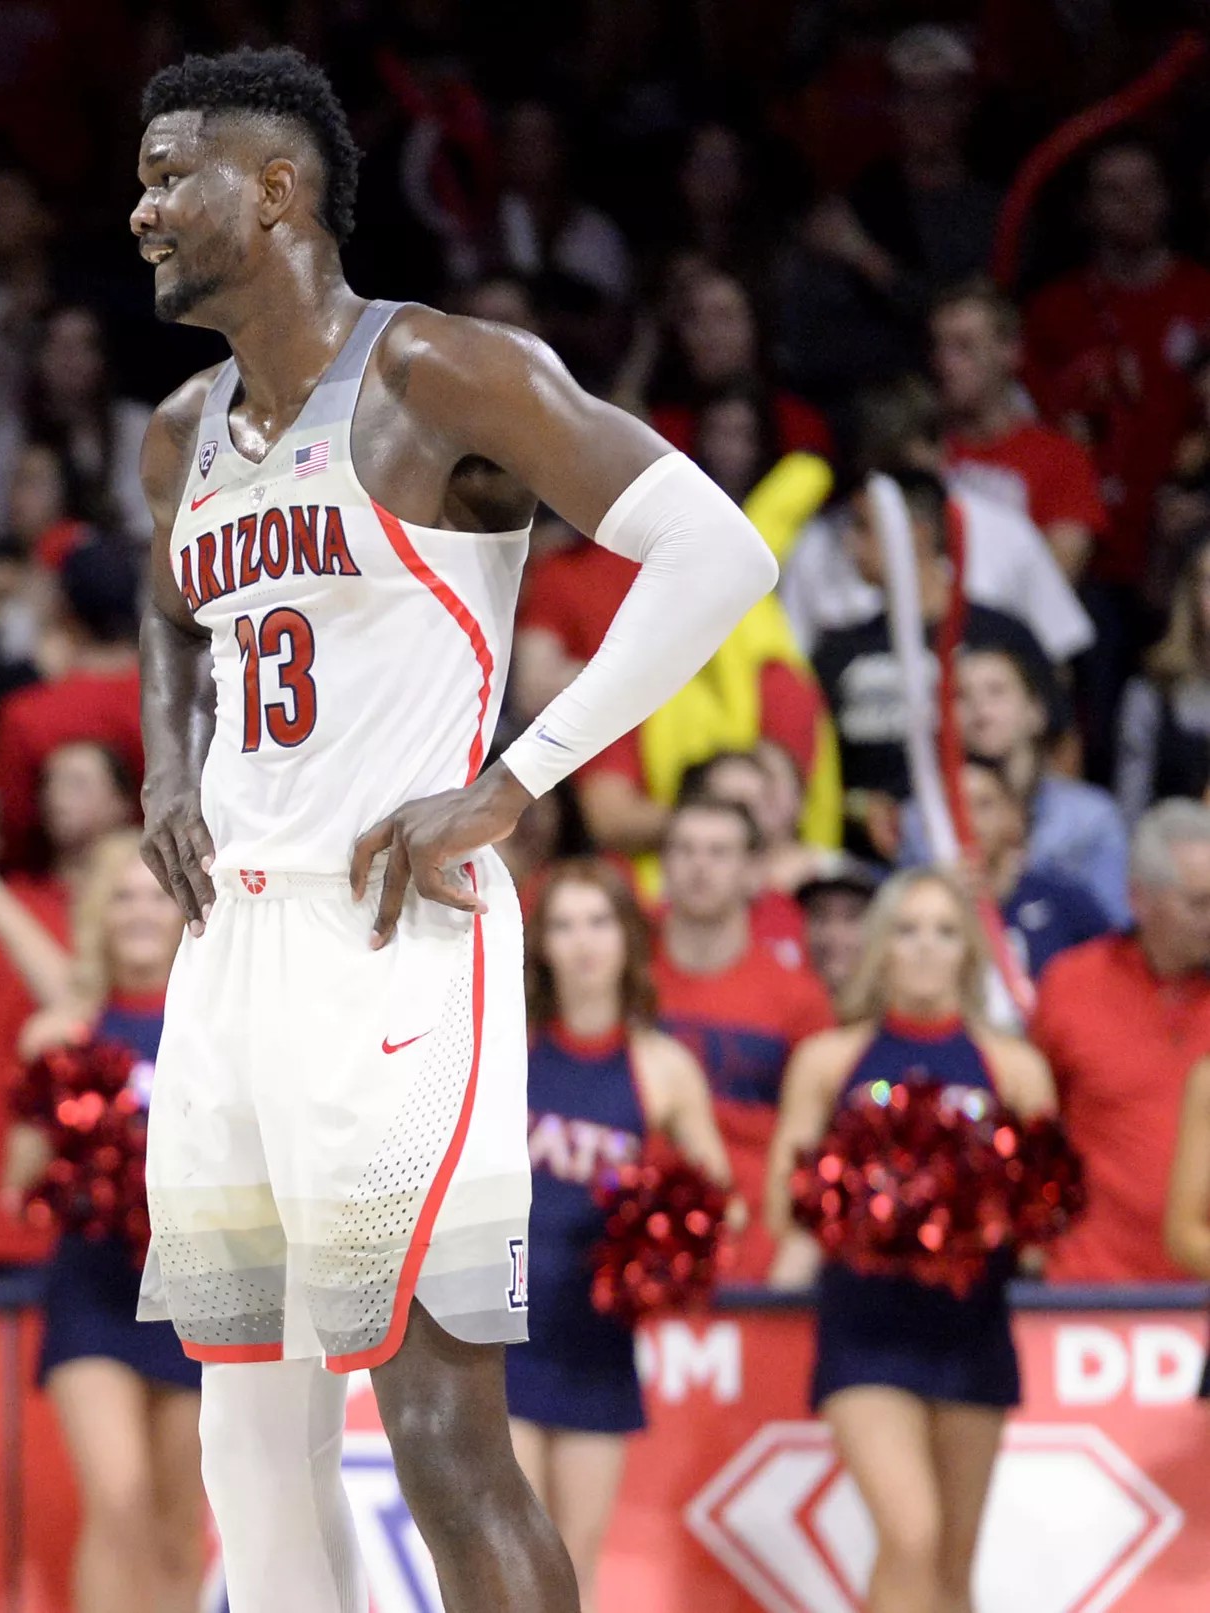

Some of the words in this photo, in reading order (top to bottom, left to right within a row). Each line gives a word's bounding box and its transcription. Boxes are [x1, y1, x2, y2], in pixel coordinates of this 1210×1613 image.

[180, 505, 362, 613] ARIZONA
[234, 607, 318, 753] 13
[1056, 1324, 1206, 1405] DD
